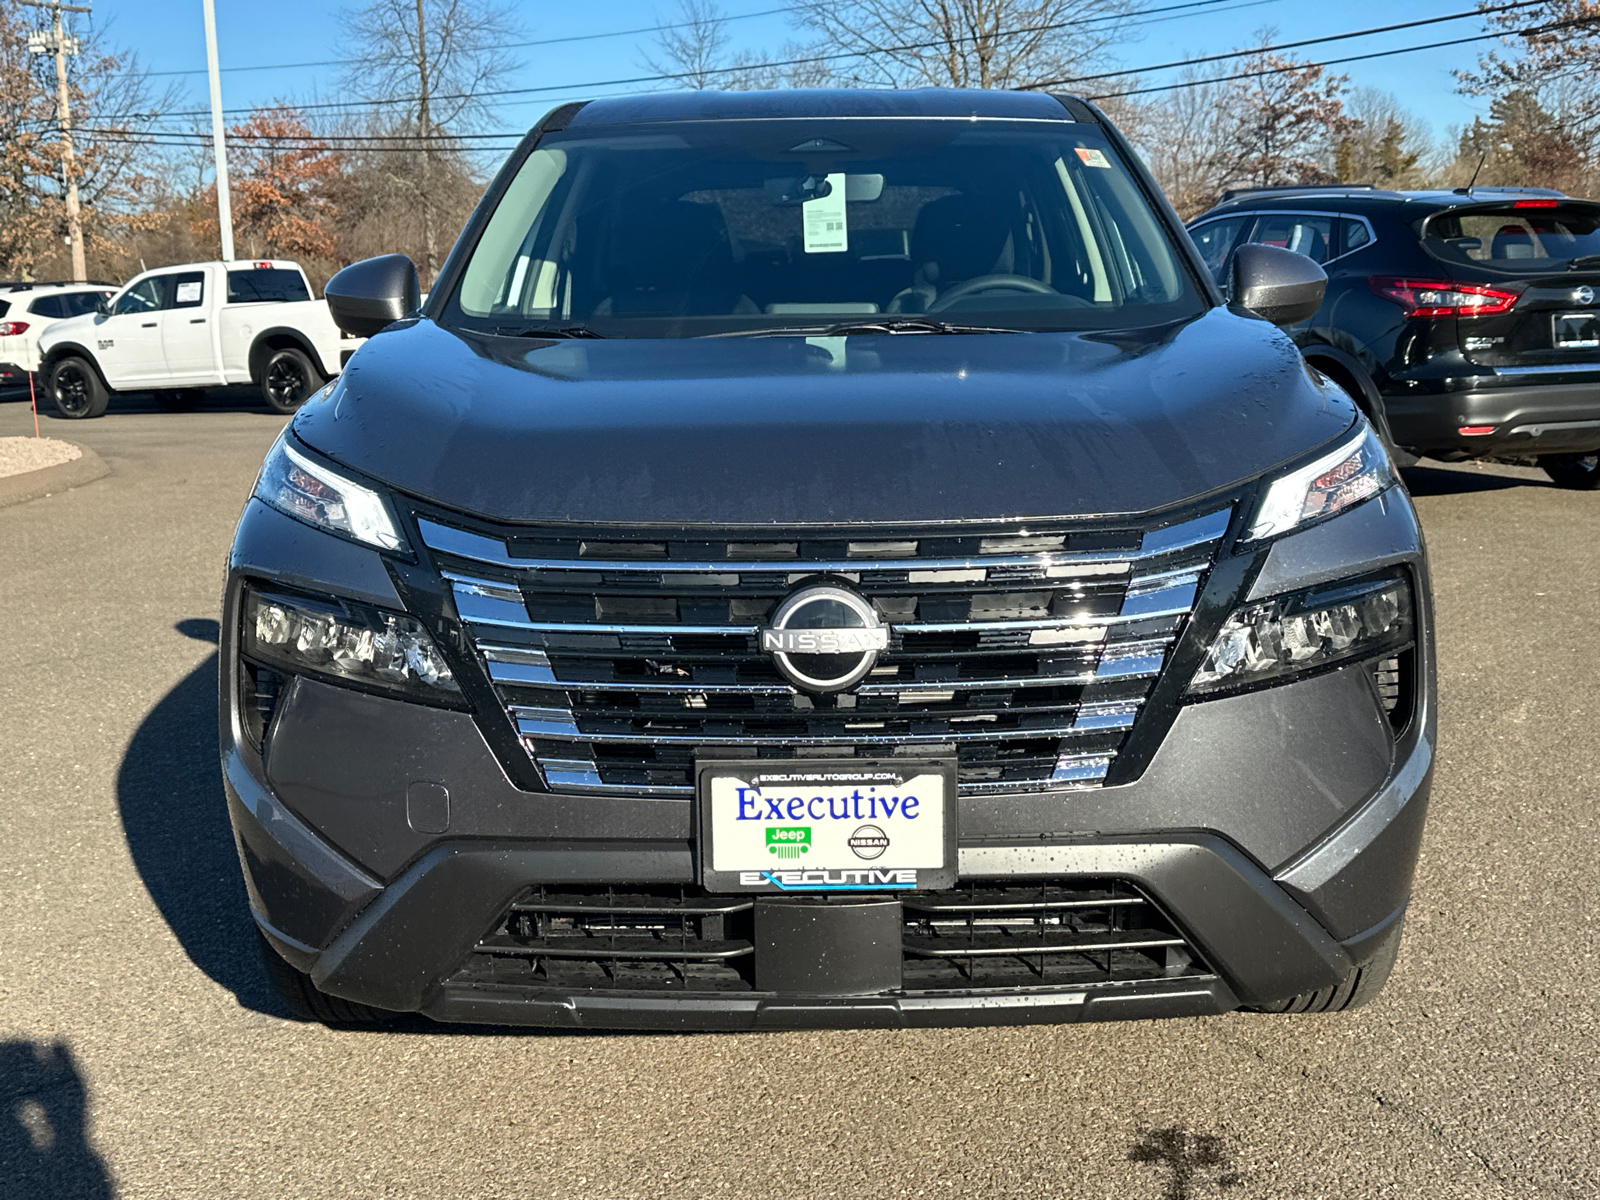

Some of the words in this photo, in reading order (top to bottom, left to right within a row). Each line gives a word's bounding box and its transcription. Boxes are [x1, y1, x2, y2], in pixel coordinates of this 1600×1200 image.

[765, 633, 886, 648] NISSAN
[759, 773, 896, 782] EXECUTIVEAUTOGROUP.COM
[735, 787, 920, 821] Executive
[771, 829, 806, 842] Jeep
[850, 838, 887, 847] NISSAN
[739, 869, 917, 885] EXECUTIVE
